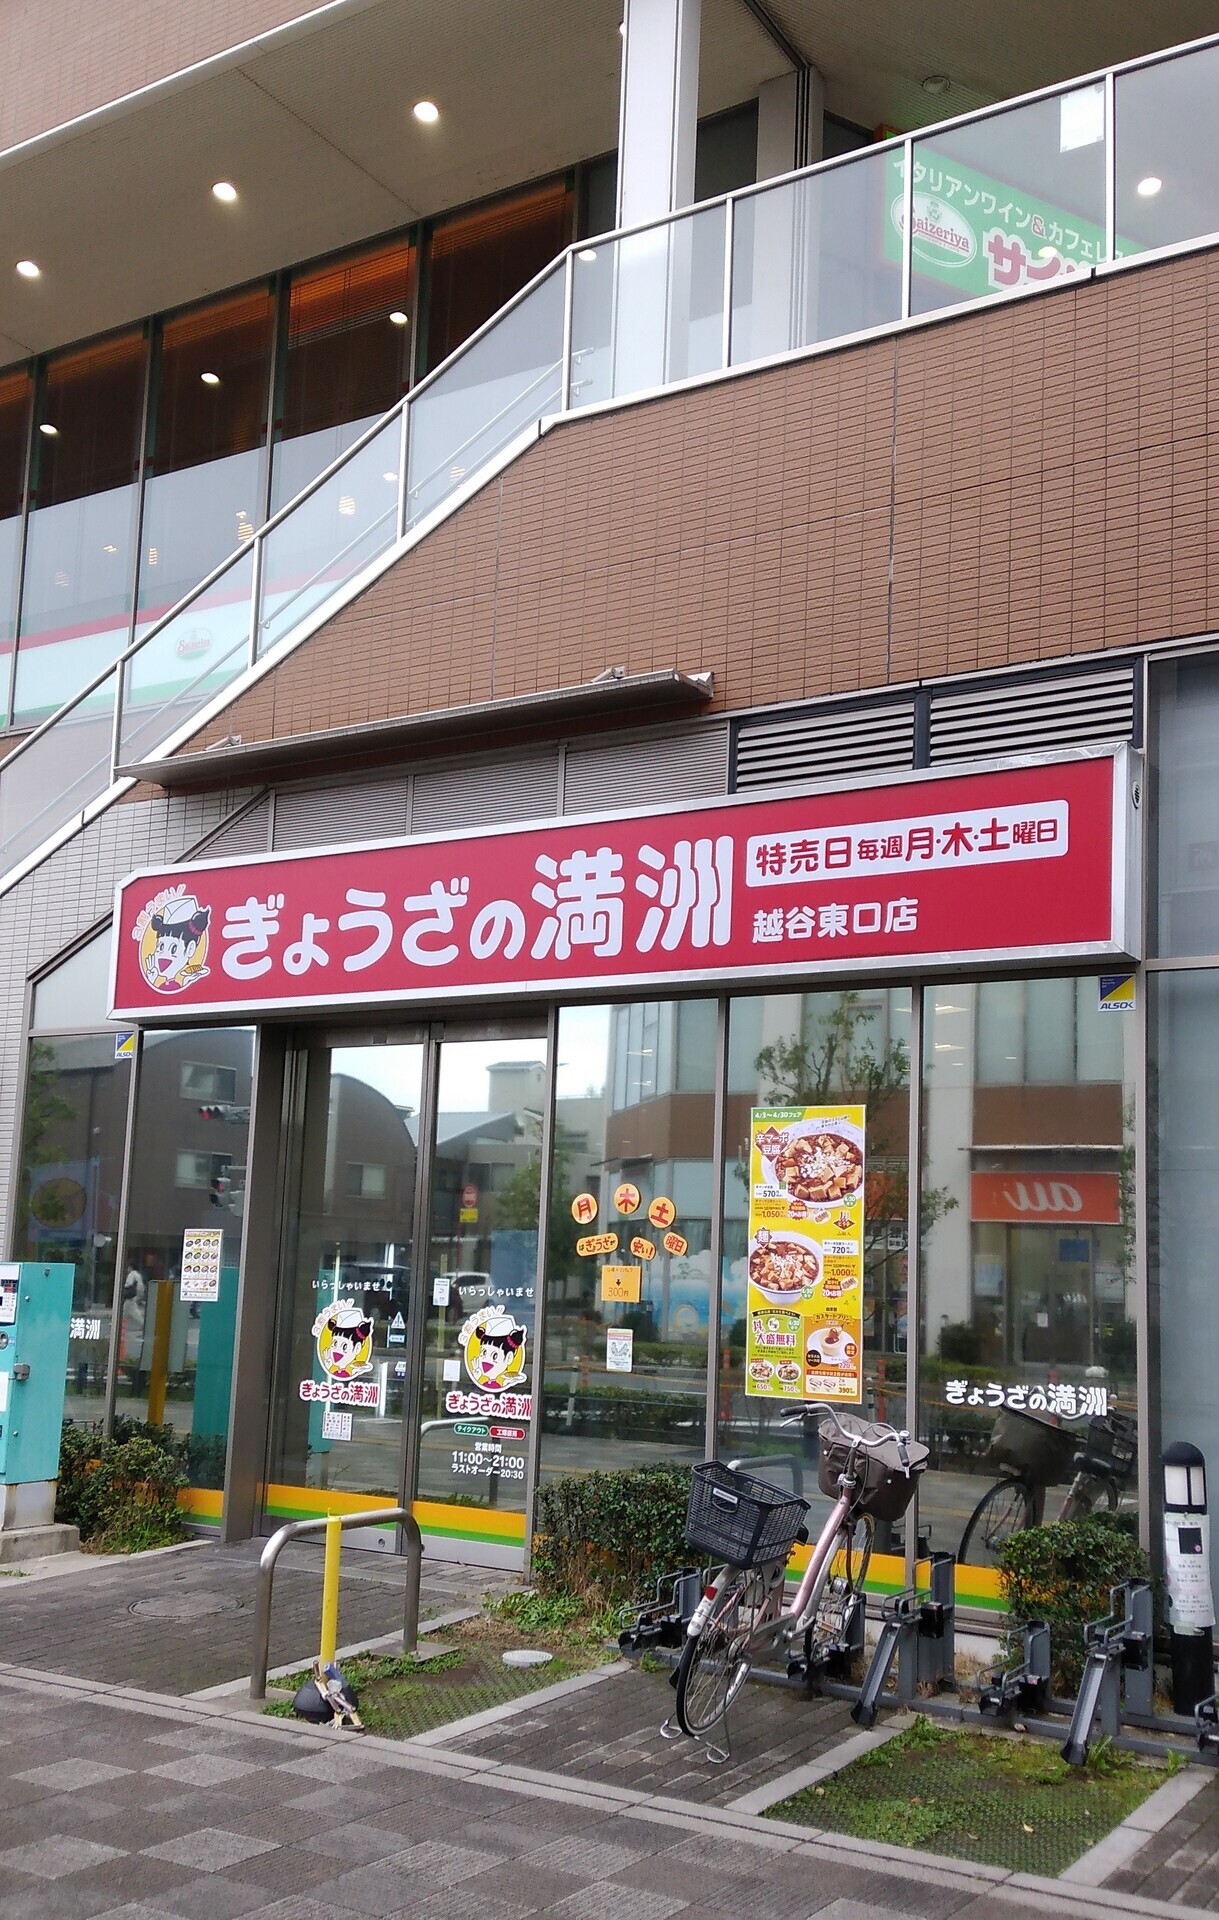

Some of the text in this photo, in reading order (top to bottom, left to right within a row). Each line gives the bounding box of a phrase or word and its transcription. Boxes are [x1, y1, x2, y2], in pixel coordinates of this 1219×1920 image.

[220, 835, 735, 980] ぎょうざの満洲
[752, 896, 919, 944] 越谷東口店
[1100, 1001, 1134, 1010] ALSOK
[577, 1188, 669, 1225] 月 木 土
[311, 1280, 381, 1291] いらっしゃいませ
[458, 1285, 535, 1298] いらっしゃいませ
[69, 1317, 101, 1340] 満洲
[300, 1381, 380, 1405] ぎょうざの満洲
[447, 1392, 533, 1418] ぎょうざの満洲
[945, 1379, 1108, 1417] ぎょうざの満洲
[474, 1441, 502, 1454] 営業時間
